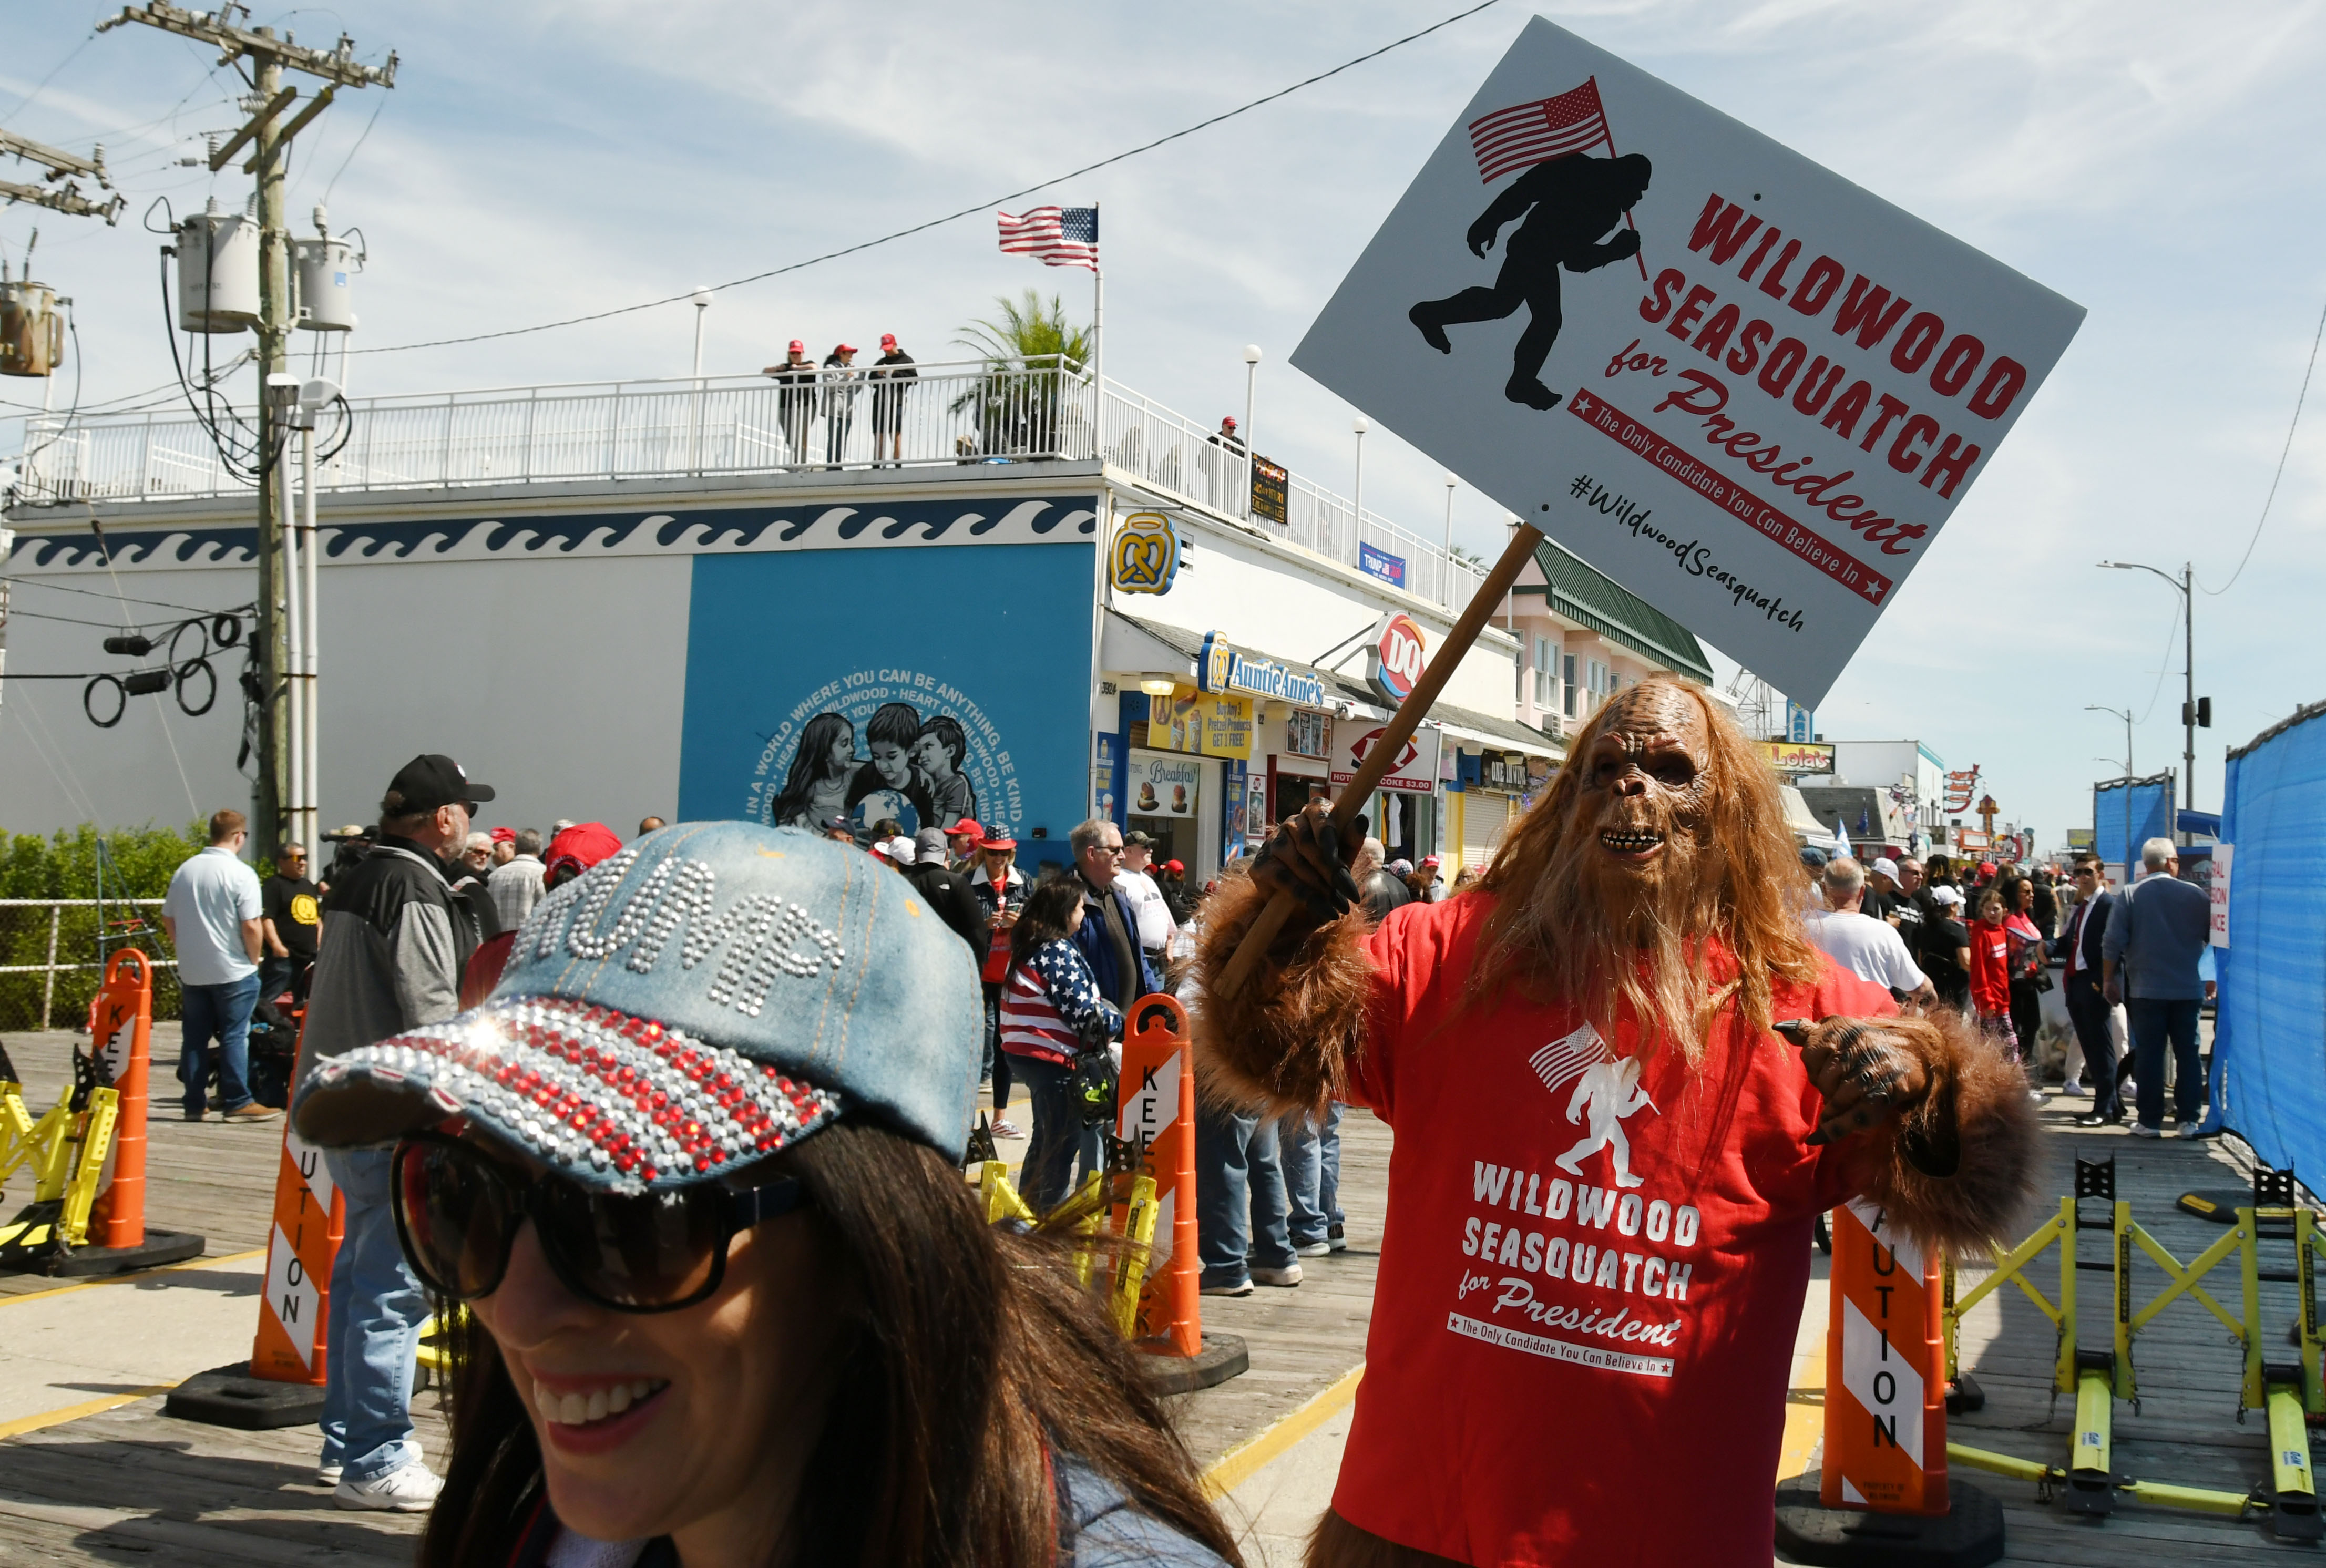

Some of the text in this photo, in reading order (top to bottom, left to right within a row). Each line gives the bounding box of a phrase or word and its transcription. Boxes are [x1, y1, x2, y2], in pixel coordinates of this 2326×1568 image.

[1687, 192, 2027, 421] WILDWOOD
[1639, 268, 1982, 501] SEASQUATCH
[1605, 338, 1929, 556] for President
[1594, 406, 1860, 585] The Only Candidate You Can Believe In
[1570, 474, 1804, 632] #WildwoodSeasquatch
[843, 670, 875, 689] YOU
[879, 669, 911, 684] CAN
[914, 672, 936, 691] BE
[1387, 629, 1421, 689] DQ
[790, 681, 841, 722] WHERE
[851, 703, 876, 719] YOU
[936, 683, 1000, 752] ANYTHING,
[1237, 702, 1242, 715] 3
[755, 720, 792, 776] WORLD
[1793, 711, 1806, 742] ARC
[774, 727, 803, 771] HEART
[820, 687, 889, 714] WILDWOOD
[899, 688, 941, 710] HEART
[941, 705, 959, 720] OF
[958, 717, 999, 788] WILDWOOD
[994, 800, 1006, 827] HEA
[970, 766, 985, 787] BE
[996, 751, 1015, 776] BE
[1491, 761, 1504, 783] ONE
[1772, 745, 1831, 769] Lola's
[751, 781, 763, 793] A
[977, 787, 991, 823] KIND
[1005, 777, 1023, 822] KIND
[1380, 778, 1403, 787] COKE
[746, 797, 759, 815] IN
[107, 1004, 124, 1082] KEE
[1473, 1160, 1700, 1247] WILDWOOD
[282, 1150, 317, 1324] UTION
[1462, 1217, 1693, 1301] SEASQUATCH
[1459, 1269, 1682, 1347] for President
[1462, 1319, 1656, 1372] The Only Candidate You Can Believe In
